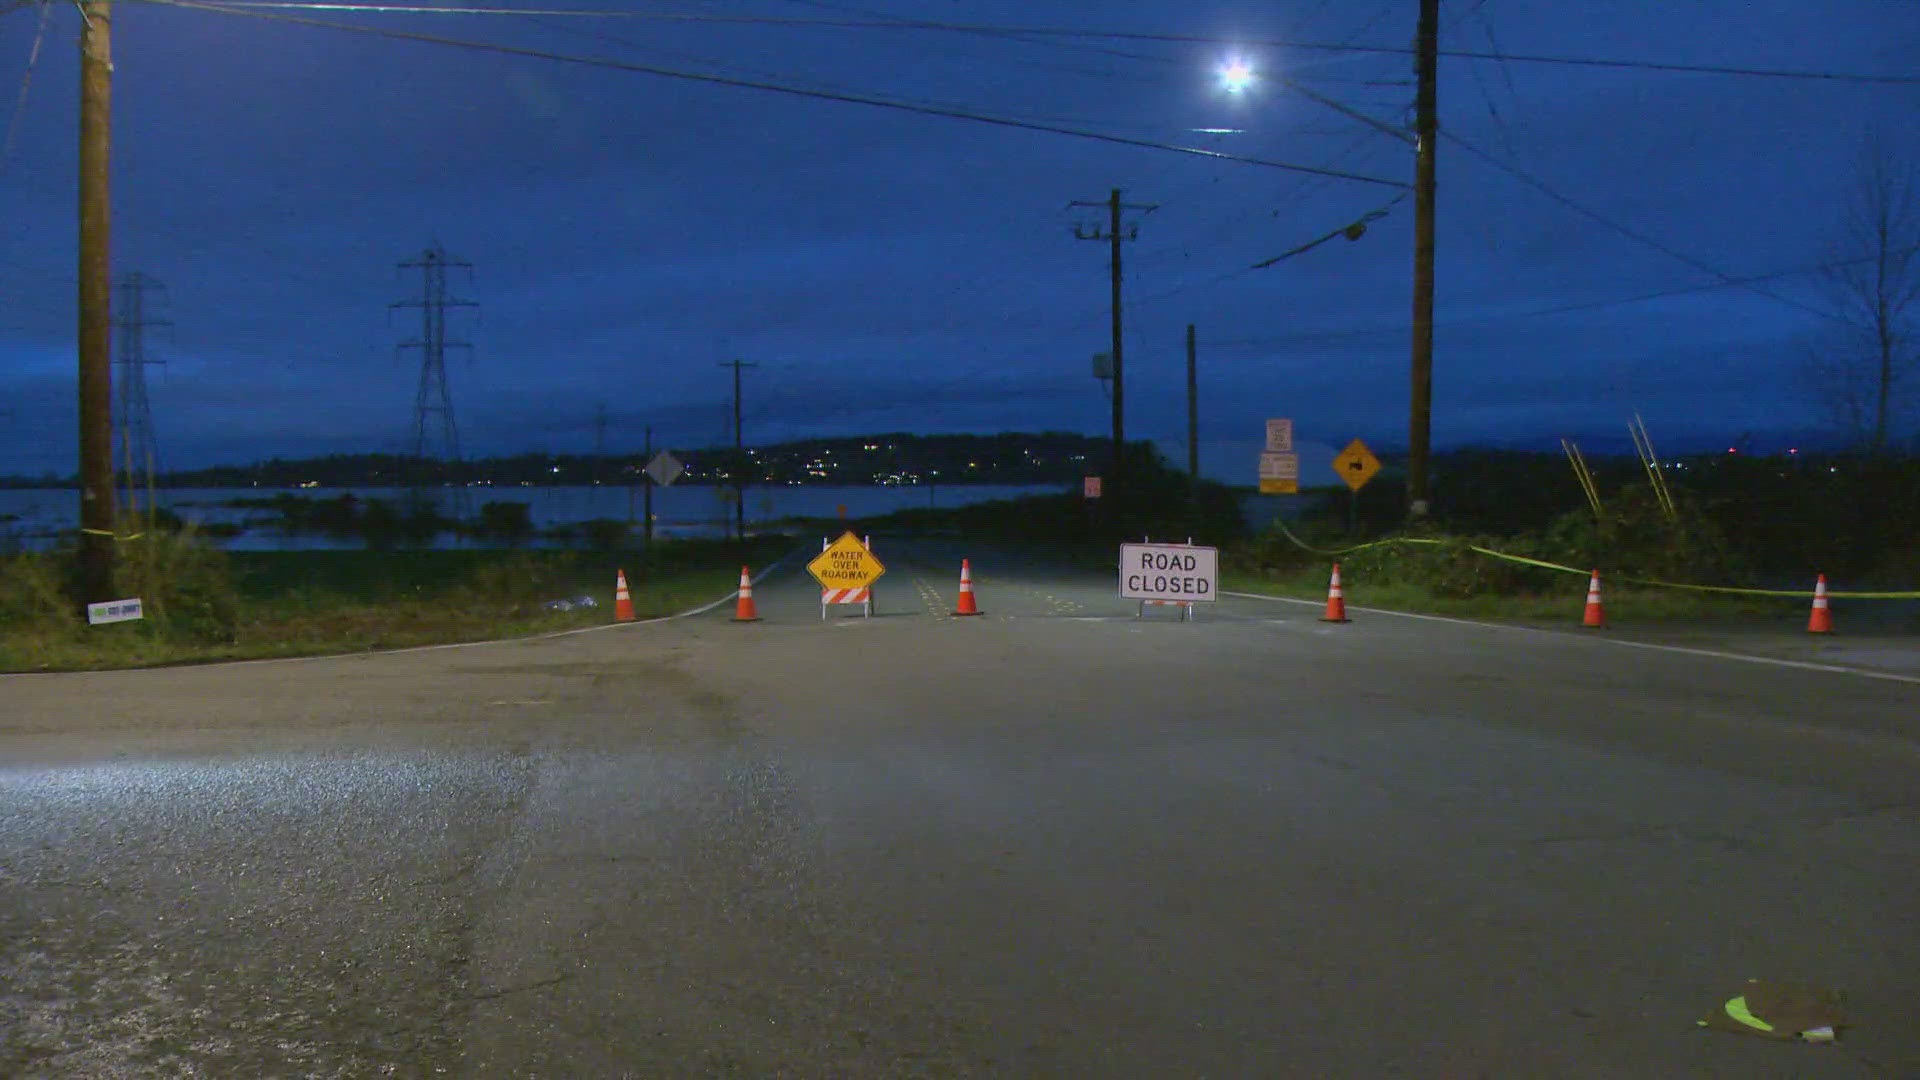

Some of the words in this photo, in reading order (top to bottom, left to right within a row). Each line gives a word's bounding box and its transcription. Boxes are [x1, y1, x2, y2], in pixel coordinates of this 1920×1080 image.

[831, 551, 863, 561] WATER
[1141, 552, 1196, 571] ROAD
[833, 560, 859, 569] OVER
[821, 569, 869, 580] ROADWAY
[1128, 575, 1209, 594] CLOSED
